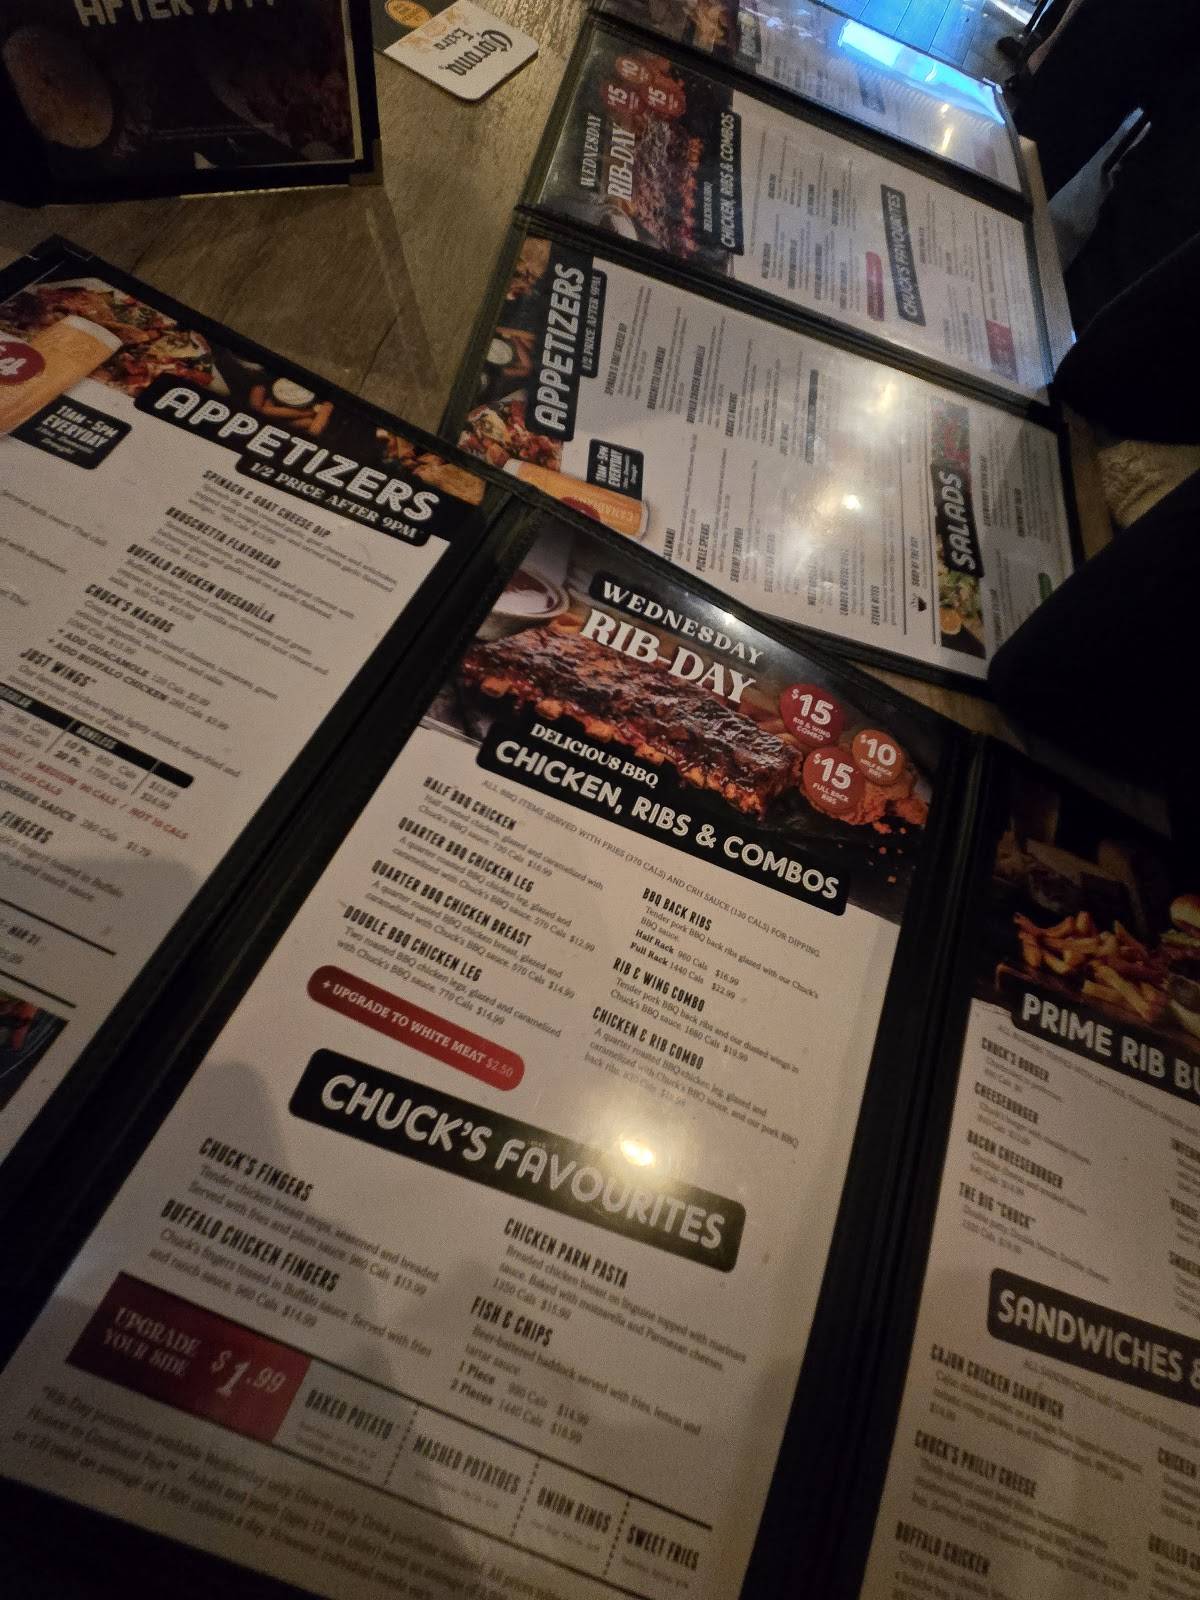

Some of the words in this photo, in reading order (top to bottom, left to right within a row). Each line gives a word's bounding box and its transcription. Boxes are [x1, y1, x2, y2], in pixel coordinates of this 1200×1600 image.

[433, 27, 475, 51] Extra
[446, 29, 513, 76] Corona
[580, 112, 601, 190] WEDNESDAY
[606, 122, 635, 202] RIB-DAY
[721, 111, 734, 163] COMBOS
[721, 160, 734, 174] &
[721, 171, 734, 197] RIBS
[582, 325, 596, 356] PRICE
[586, 295, 599, 328] AFTER
[535, 262, 585, 430] APPETIZERS
[41, 413, 109, 450] EVERYDAY
[55, 404, 86, 424] 11AM
[91, 420, 119, 438] 5PM
[153, 381, 442, 525] APPETIZERS
[201, 468, 245, 496] SPINACH
[276, 506, 313, 530] CHEESE
[311, 523, 332, 539] DIP
[249, 461, 275, 478] 1/2
[274, 472, 323, 498] PRICE
[324, 493, 380, 522] AFTER
[379, 516, 417, 538] 9PM
[938, 471, 976, 571] SALADS
[125, 542, 173, 572] BUFFALO
[168, 564, 217, 594] CHICKEN
[164, 505, 228, 543] BRUSCHETTA
[225, 536, 282, 570] FLATBREAD
[84, 582, 133, 613] CHUCK'S
[128, 604, 176, 634] NACHOS
[598, 581, 763, 666] WEDNESDAY
[18, 645, 53, 670] JUST
[578, 608, 756, 706] RIB-DAY
[791, 688, 834, 725] $15
[529, 722, 622, 772] DELICIOUS
[620, 761, 660, 789] BBQ
[813, 753, 854, 789] $15
[860, 734, 897, 766] $10
[422, 775, 451, 797] HALF
[449, 789, 473, 808] BBQ
[471, 800, 517, 831] CHICKEN
[492, 736, 629, 815] CHICKEN,
[630, 795, 693, 838] RIBS
[693, 821, 720, 850] &
[720, 832, 841, 901] COMBOS
[396, 815, 446, 849] QUARTER
[444, 839, 468, 860] BBQ
[466, 850, 514, 883] CHICKEN
[513, 873, 535, 893] LEG
[369, 859, 422, 894] QUARTER
[419, 882, 445, 905] BBQ
[442, 894, 492, 928] CHICKEN
[489, 917, 532, 948] BREAST
[641, 887, 662, 906] BBQ
[662, 897, 688, 920] BACK
[688, 910, 713, 932] RIBS
[342, 904, 388, 937] DOUBLE
[386, 925, 412, 948] BBQ
[409, 937, 460, 972] CHICKEN
[459, 961, 483, 983] LEG
[629, 941, 647, 956] Full
[646, 949, 669, 967] Rack
[668, 960, 688, 976] 1440
[687, 969, 705, 985] Cals
[634, 928, 654, 944] Half
[653, 937, 675, 955] Rack
[691, 956, 709, 971] Cals
[714, 967, 740, 987] $16.99
[644, 906, 670, 926] Tender
[669, 918, 688, 934] pork
[687, 927, 706, 943] BBQ
[705, 936, 724, 952] back
[723, 945, 738, 959] ribs
[737, 952, 762, 971] glazed
[761, 964, 778, 979] with
[778, 972, 791, 985] our
[791, 978, 820, 1000] Chuck's
[612, 956, 632, 975] RIB
[632, 966, 641, 980] &
[642, 971, 670, 995] WING
[670, 985, 706, 1013] COMBO
[331, 983, 391, 1019] UPGRADE
[388, 1010, 410, 1029] TO
[408, 1019, 451, 1048] WHITE
[449, 1038, 487, 1065] MEAT
[591, 1005, 638, 1039] CHICKEN
[638, 1027, 648, 1043] &
[648, 1032, 667, 1053] RIB
[668, 1042, 705, 1071] COMBO
[1019, 991, 1114, 1057] PRIME
[1119, 1034, 1167, 1080] RIB
[197, 1136, 259, 1178] CHUCK'S
[254, 1161, 315, 1203] FINGERS
[316, 1069, 495, 1165] CHUCK'S
[493, 1135, 727, 1252] FAVOURITES
[957, 1181, 977, 1204] THE
[976, 1190, 995, 1212] BIG
[159, 1197, 224, 1241] BUFFALO
[218, 1223, 284, 1268] CHICKEN
[279, 1250, 341, 1294] FINGERS
[502, 1216, 558, 1256] CHICKEN
[556, 1241, 592, 1272] PARM
[591, 1256, 630, 1289] PASTA
[109, 1305, 202, 1359] UPGRADE
[469, 1294, 503, 1325] FISH
[500, 1308, 514, 1330] &
[512, 1314, 554, 1348] CHIPS
[995, 1286, 1185, 1384] SANDWICHES
[201, 1346, 288, 1415] $1.99
[965, 1359, 1011, 1396] CHICKEN
[665, 1540, 700, 1572] FRIES
